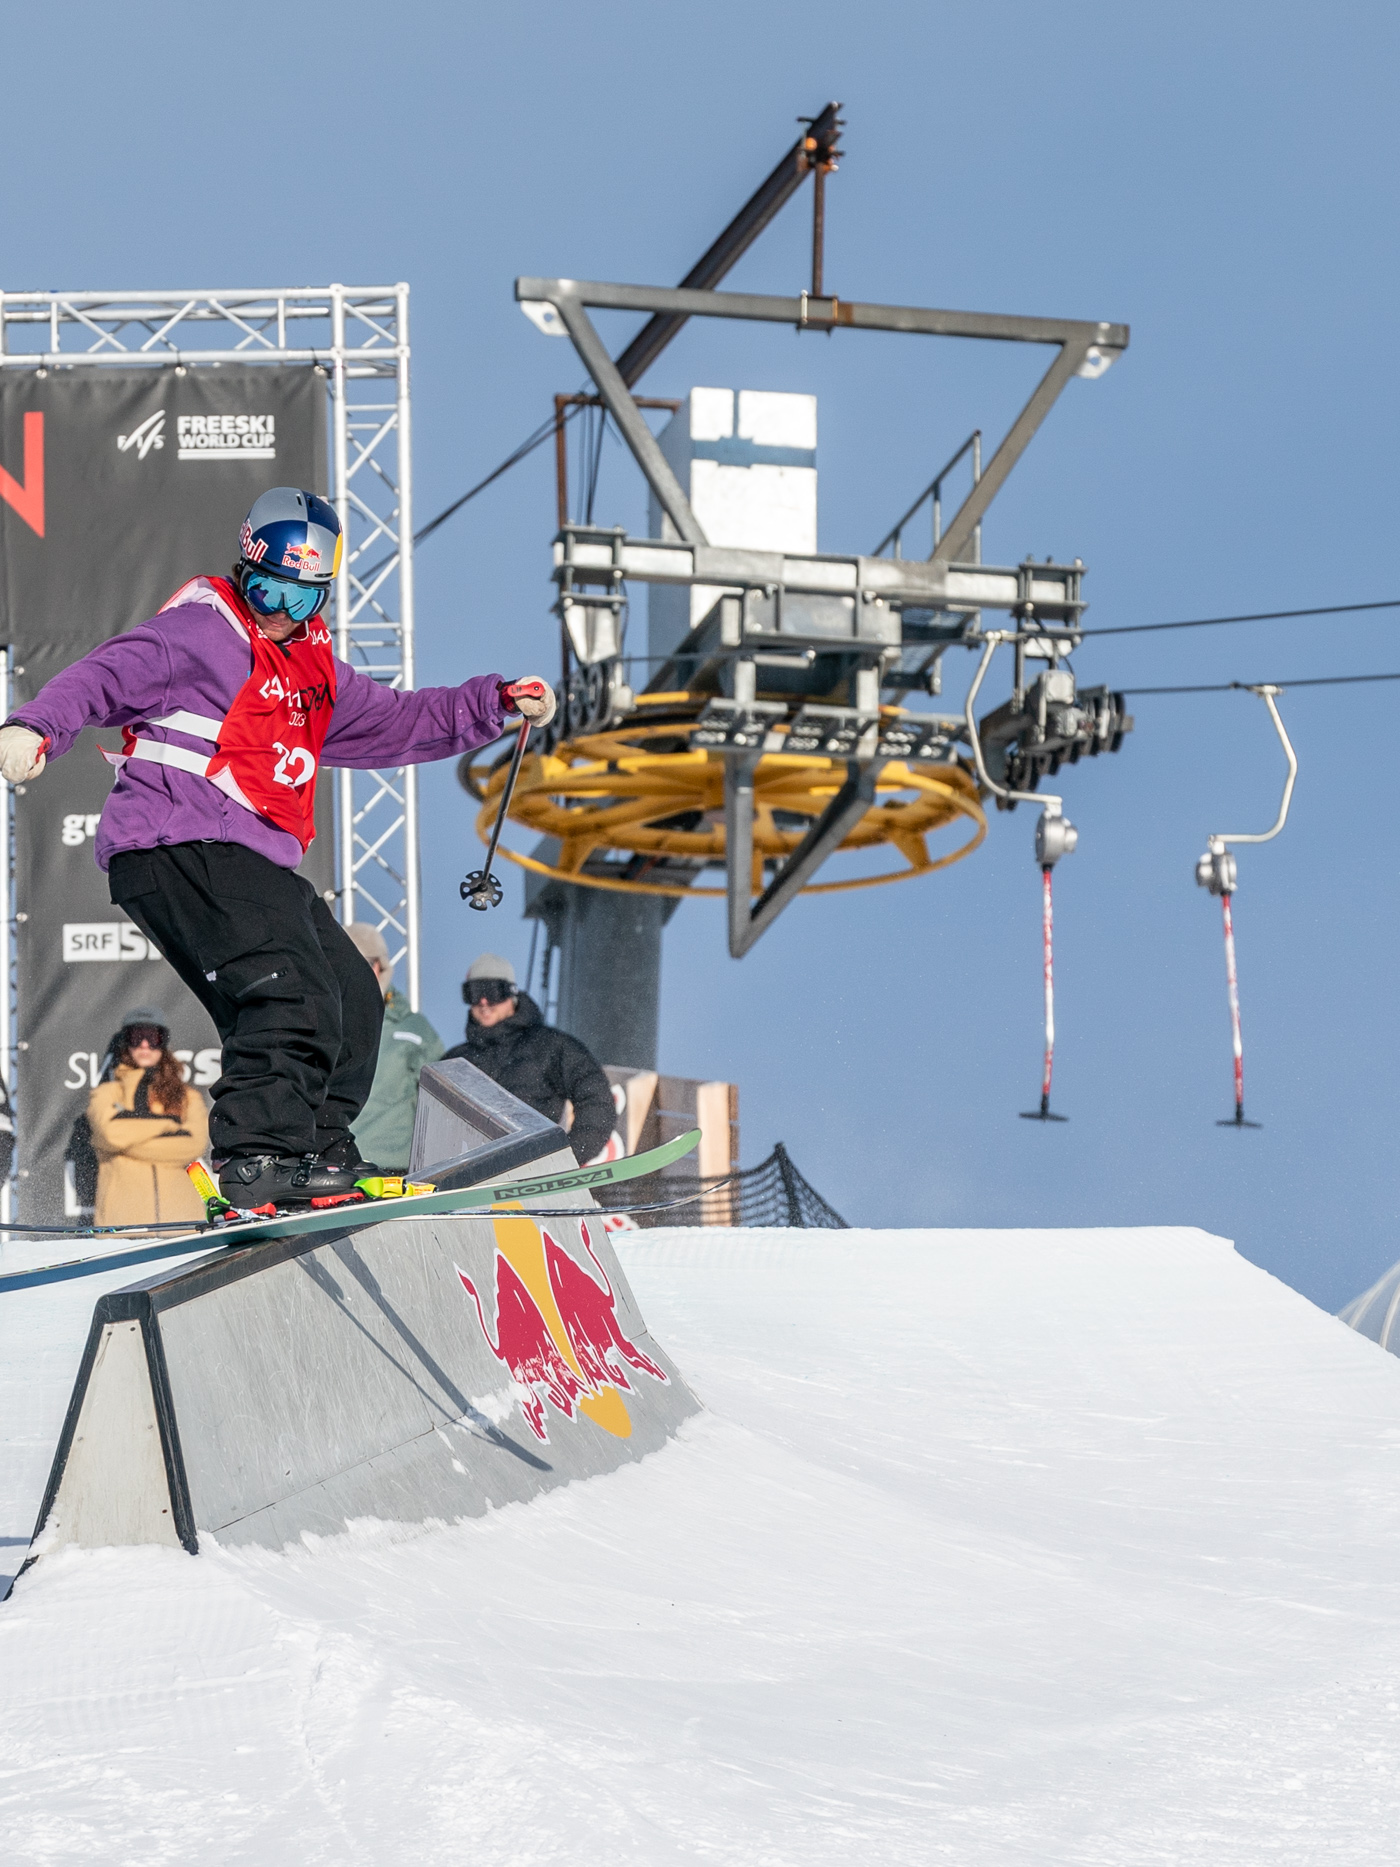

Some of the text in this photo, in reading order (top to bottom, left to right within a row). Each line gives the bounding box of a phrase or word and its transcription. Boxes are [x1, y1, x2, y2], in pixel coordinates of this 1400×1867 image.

[177, 414, 275, 434] FREESKI
[178, 433, 276, 448] WORLD CUP
[282, 555, 321, 572] Red Bull
[71, 933, 113, 951] SRF
[500, 1170, 609, 1199] FACTION
